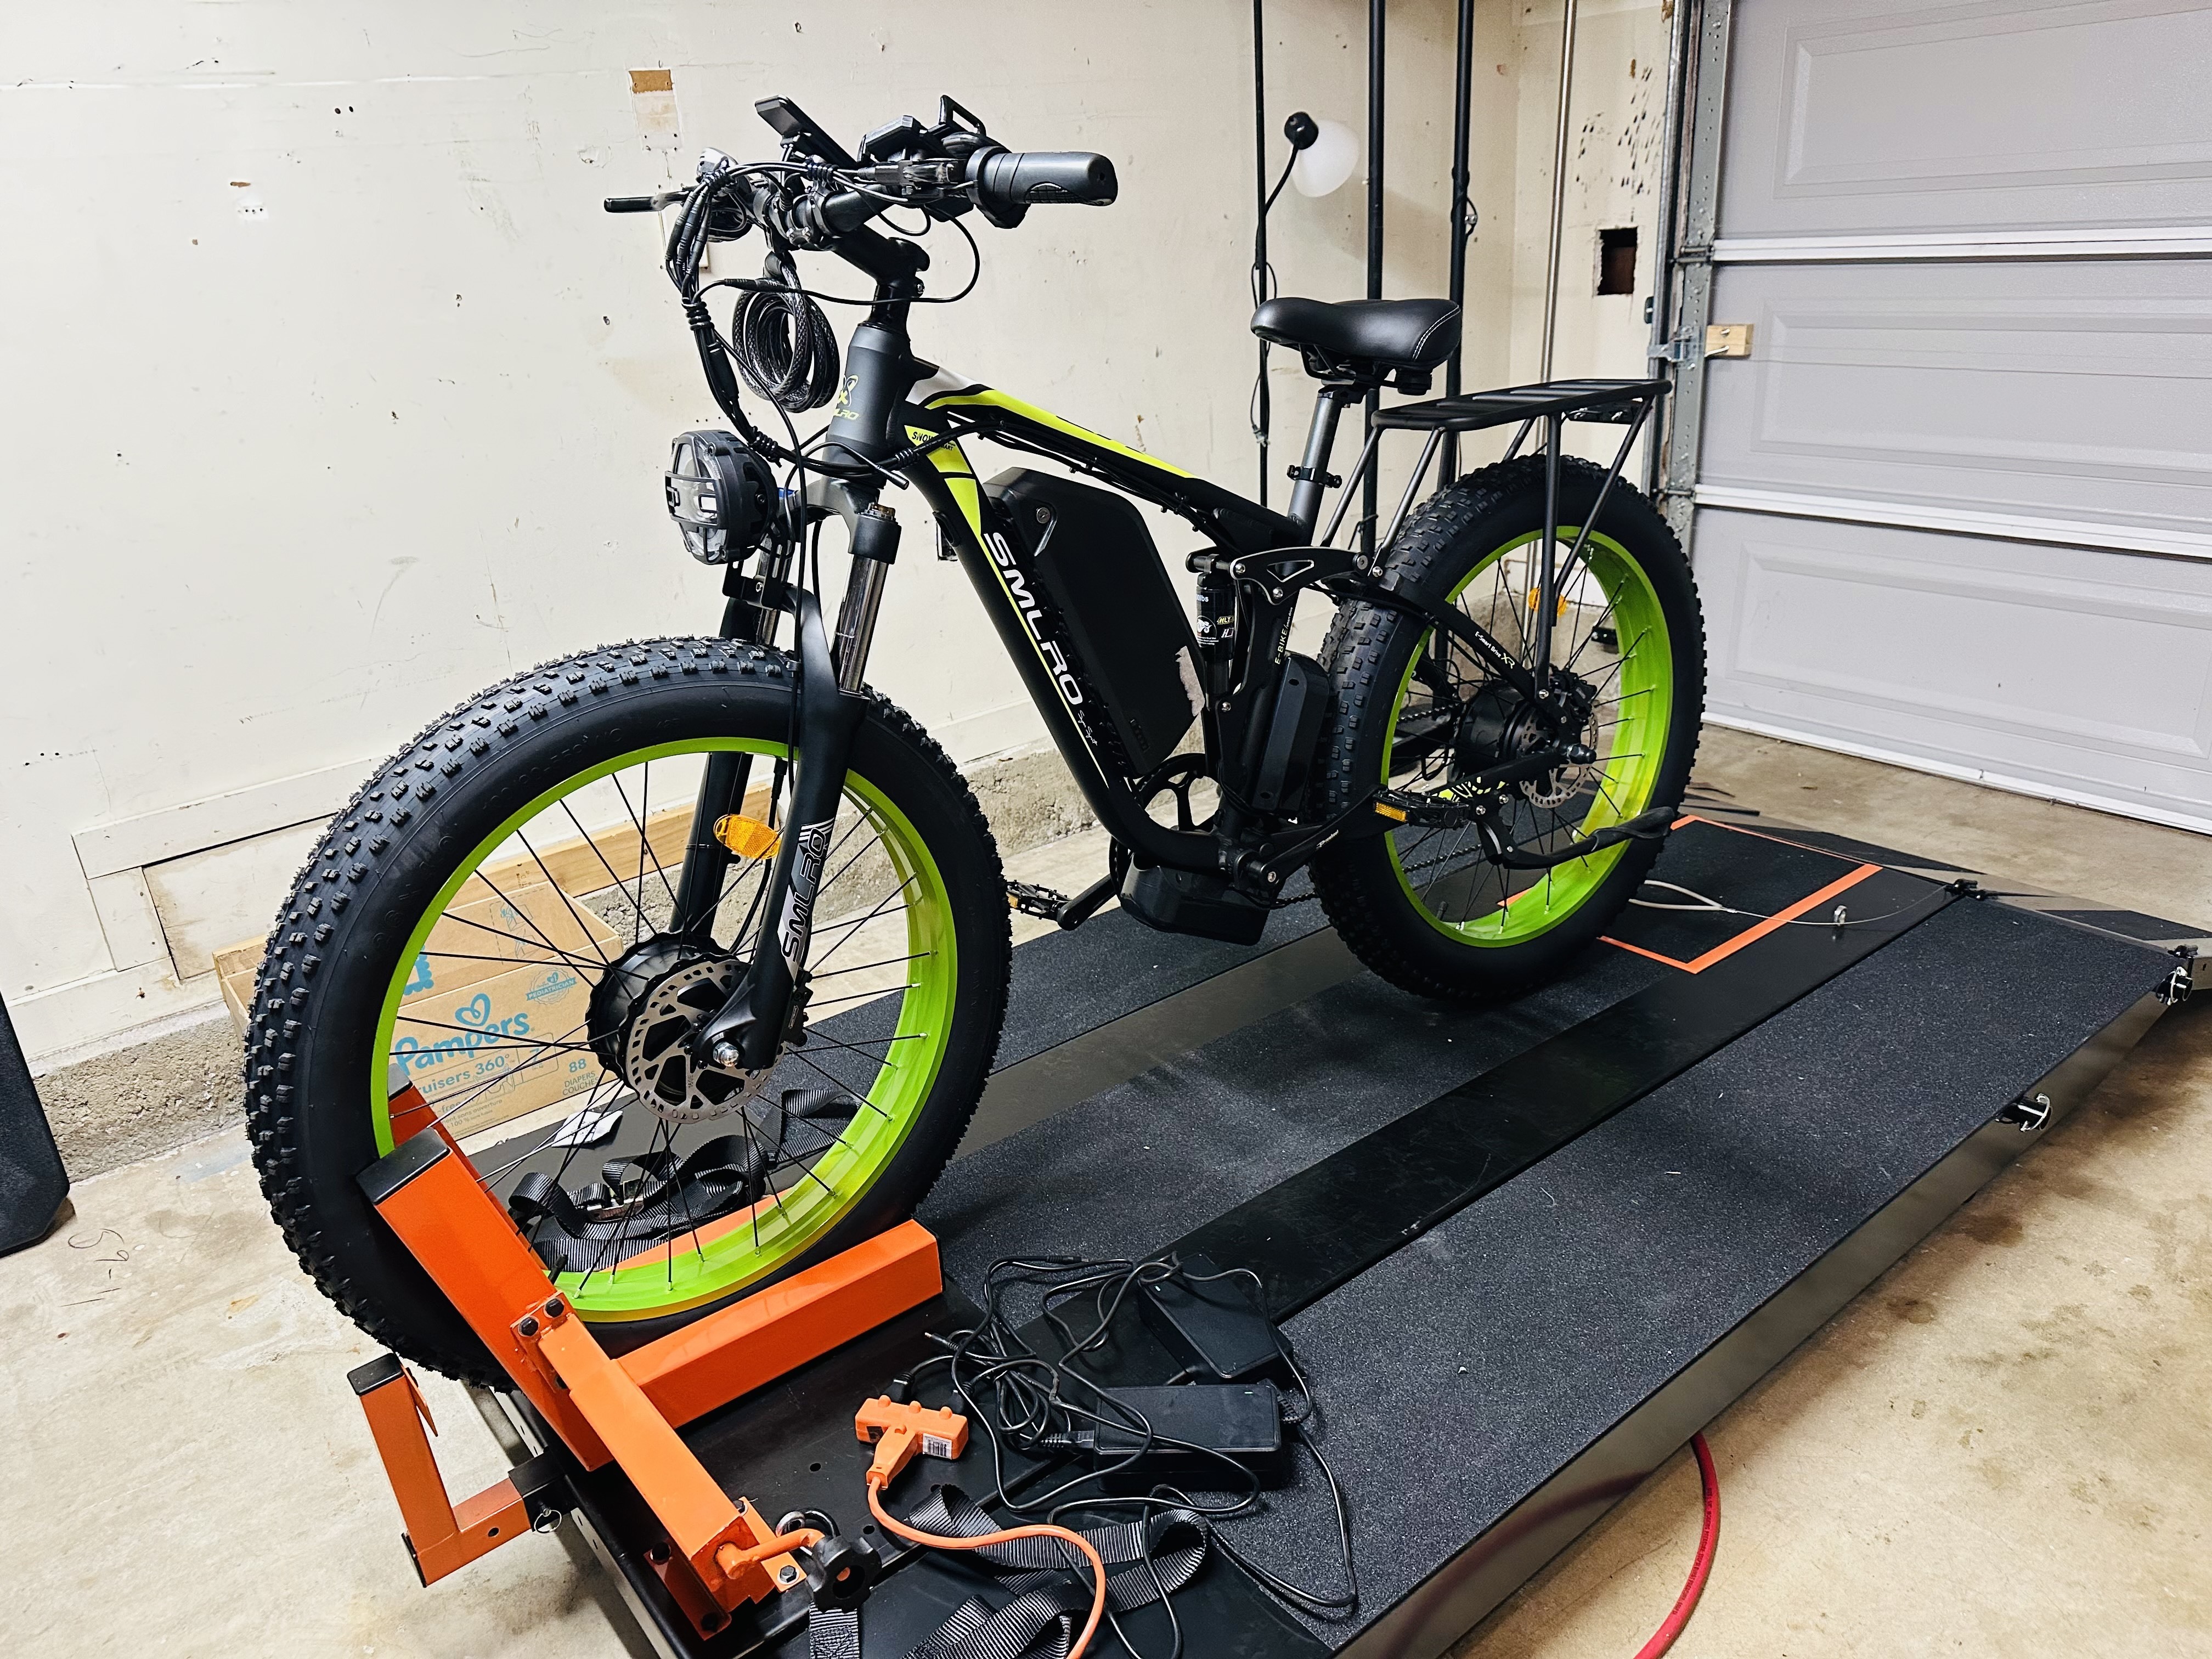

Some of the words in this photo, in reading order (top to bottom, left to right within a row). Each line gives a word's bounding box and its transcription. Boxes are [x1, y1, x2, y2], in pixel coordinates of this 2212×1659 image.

[983, 532, 1083, 705] SMLRO
[1475, 631, 1492, 648] E-Smart
[1490, 646, 1502, 658] Drive
[1501, 652, 1515, 669] XR
[782, 828, 827, 962] SMLRO
[528, 980, 575, 999] PEDIATRICIAN
[395, 1013, 531, 1076] Pampers
[568, 1058, 587, 1073] 88
[418, 1070, 471, 1094] uisers
[562, 1076, 599, 1096] COUCHES
[564, 1070, 596, 1087] DIAPERS
